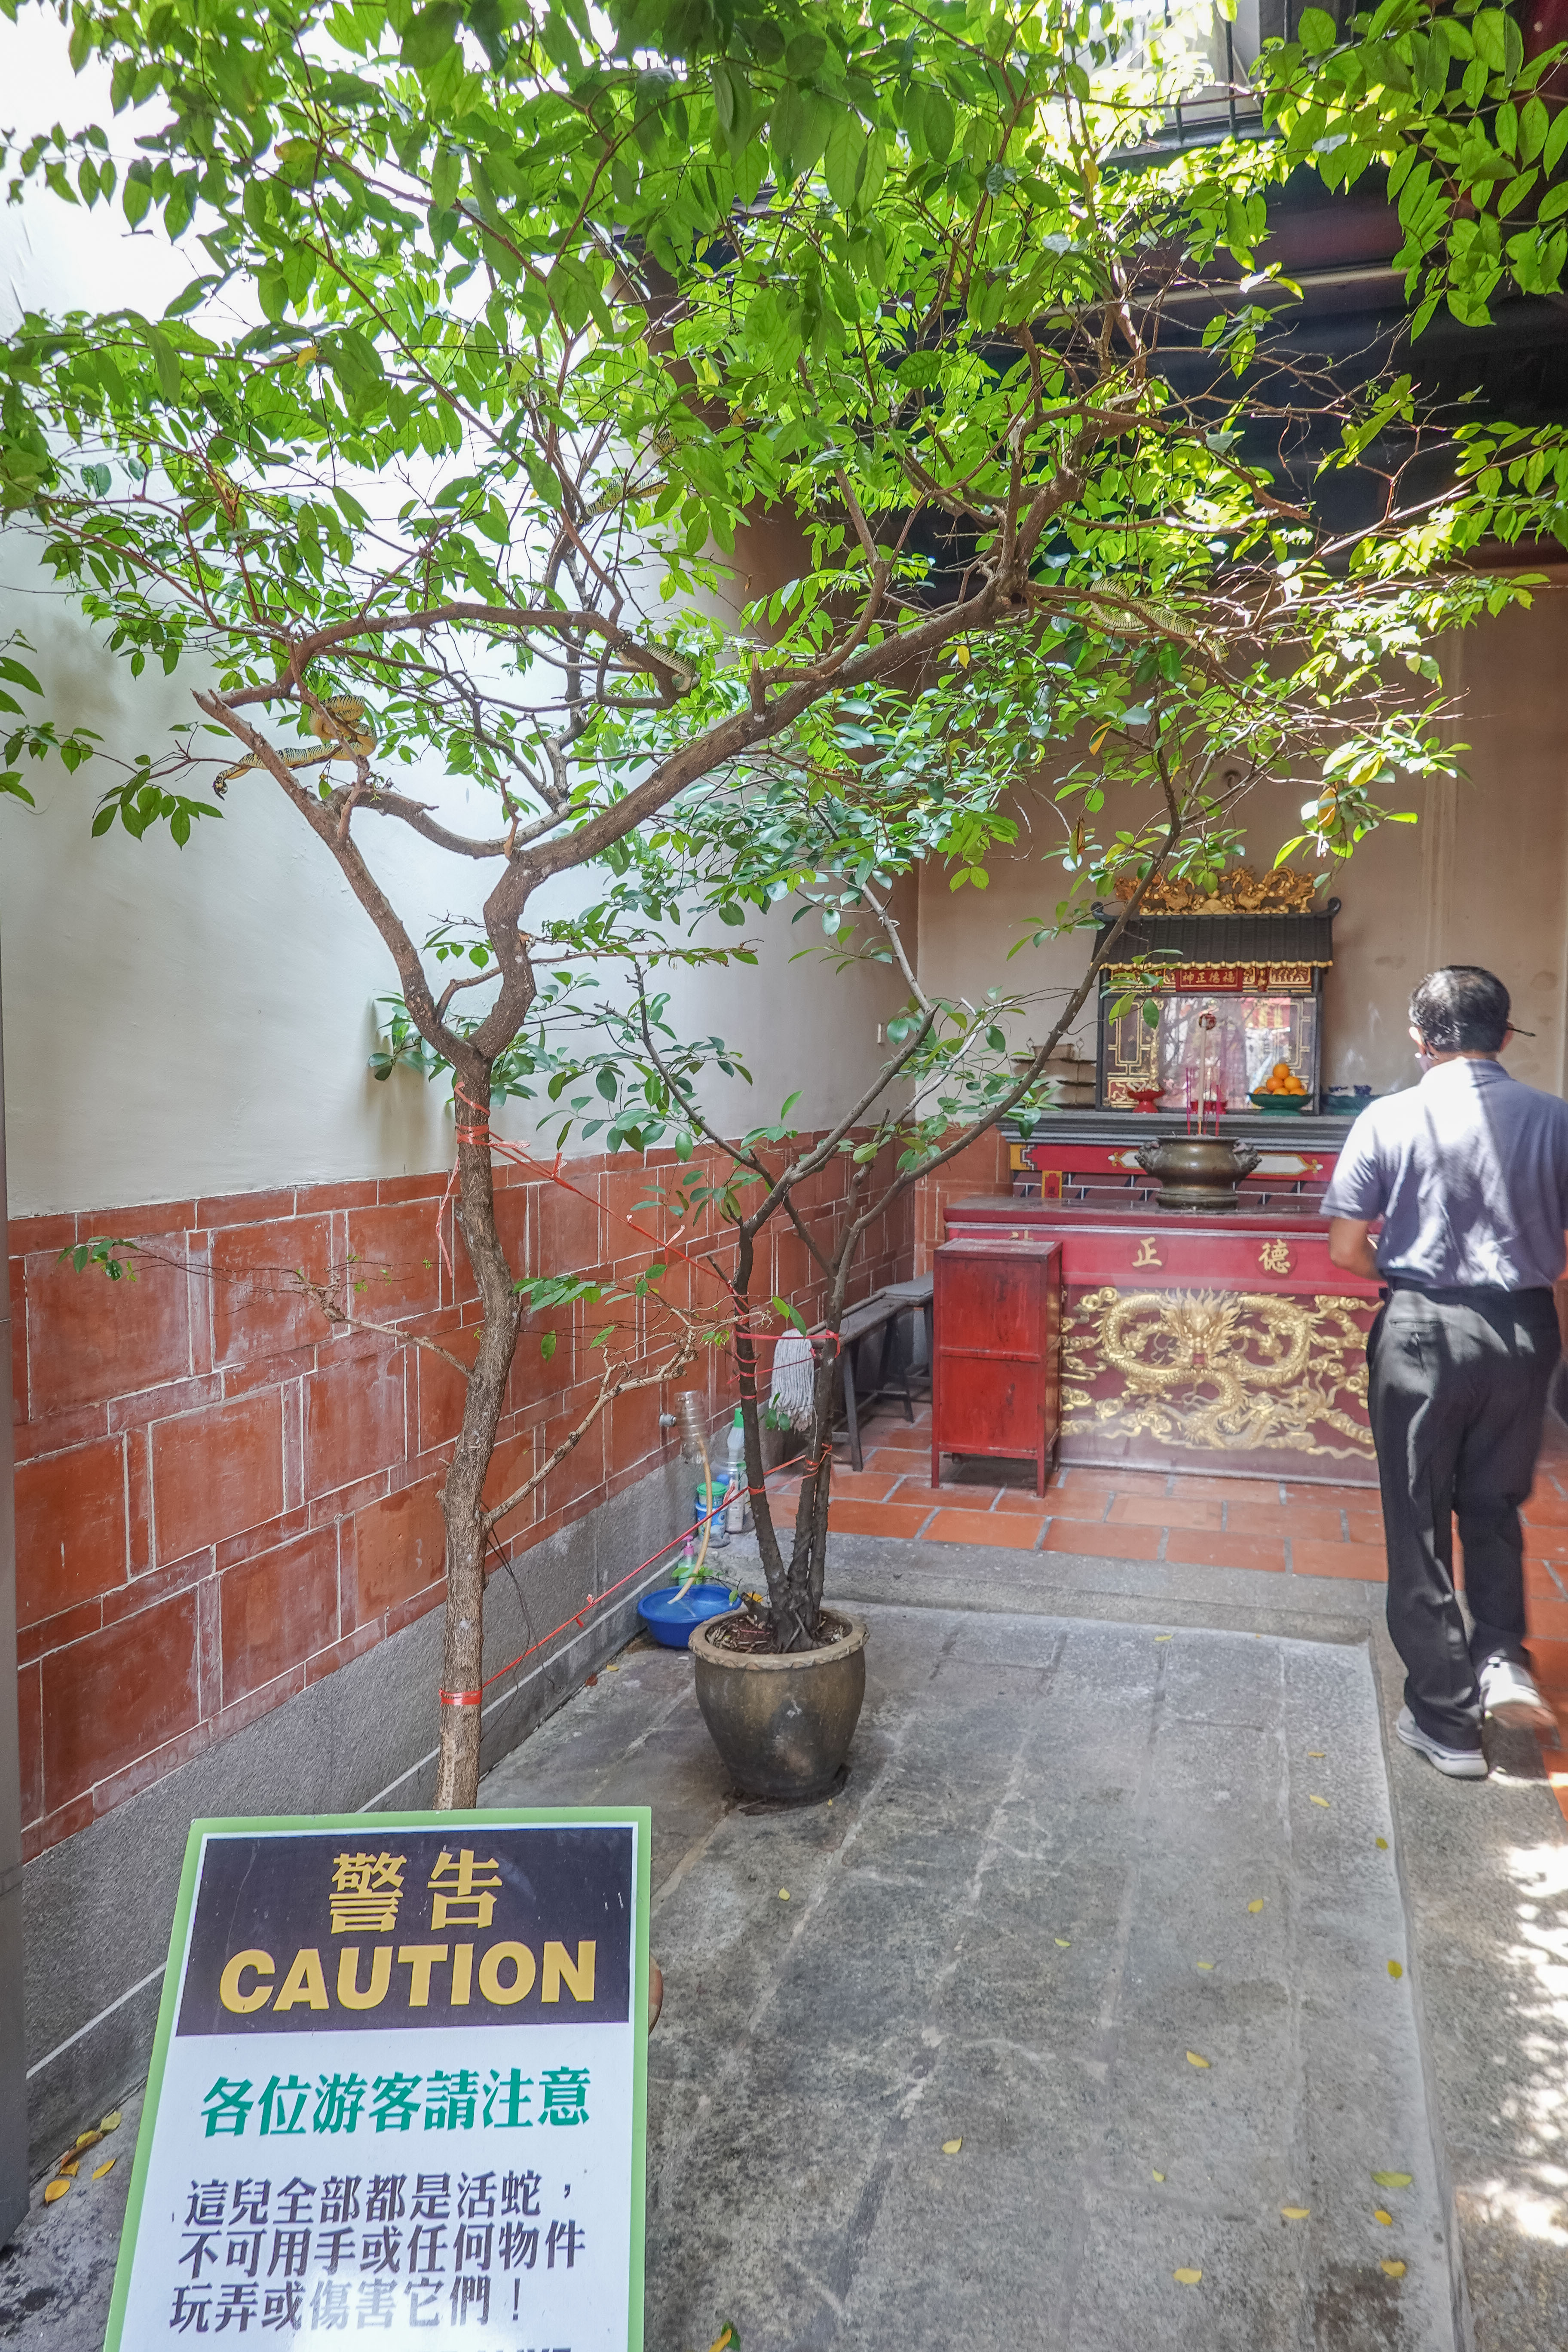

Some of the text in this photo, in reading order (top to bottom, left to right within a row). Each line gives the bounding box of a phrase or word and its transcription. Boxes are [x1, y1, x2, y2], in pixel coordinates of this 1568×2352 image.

[329, 1850, 502, 1934] 警告
[219, 1941, 596, 2013] CAUTION
[201, 2066, 591, 2138] 各位游客請注意
[178, 2219, 585, 2280] 不可用手或任何物件
